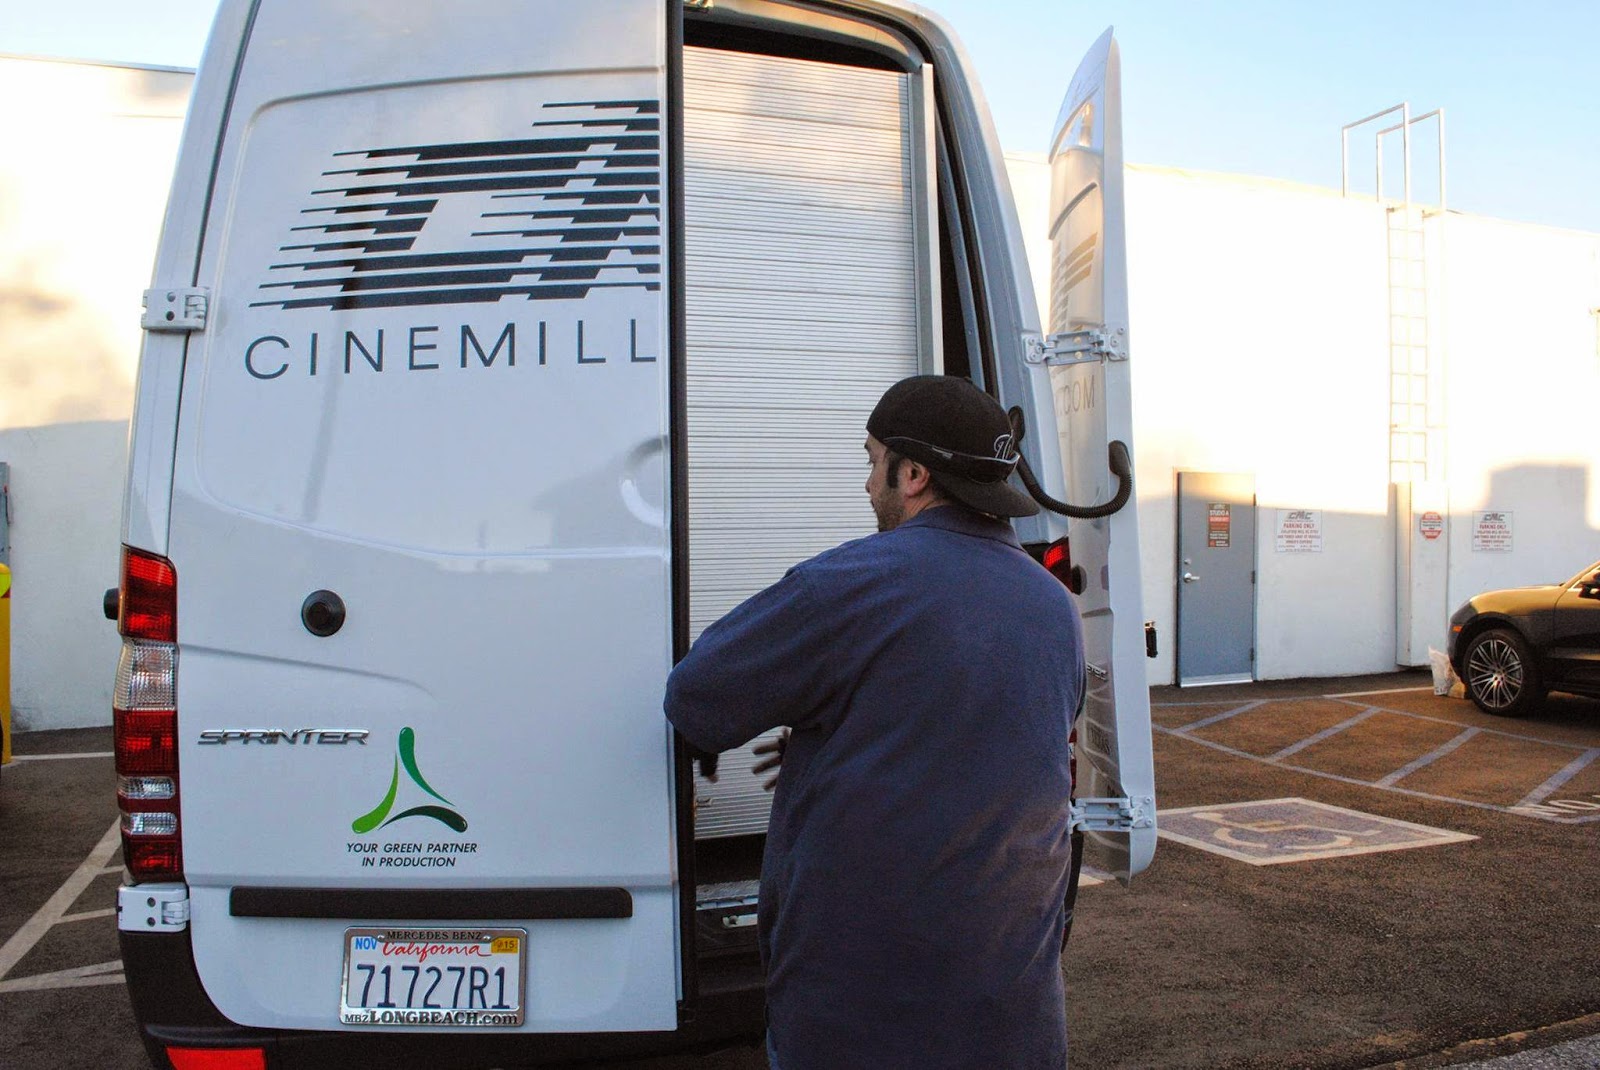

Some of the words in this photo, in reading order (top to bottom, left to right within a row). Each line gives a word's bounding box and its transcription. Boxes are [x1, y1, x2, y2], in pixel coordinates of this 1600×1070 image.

[245, 318, 657, 380] CINEMILL
[198, 728, 370, 745] SPRINTER
[347, 843, 378, 853] YOUR
[383, 843, 422, 853] GREEN
[427, 843, 478, 853] PARTNER
[362, 857, 376, 867] IN
[379, 857, 456, 867] PRODUCTION
[386, 931, 448, 940] MERCEDES
[452, 931, 483, 940] BENZ
[355, 937, 378, 950] NOV
[382, 942, 492, 963] California
[356, 964, 511, 1010] 71727R1
